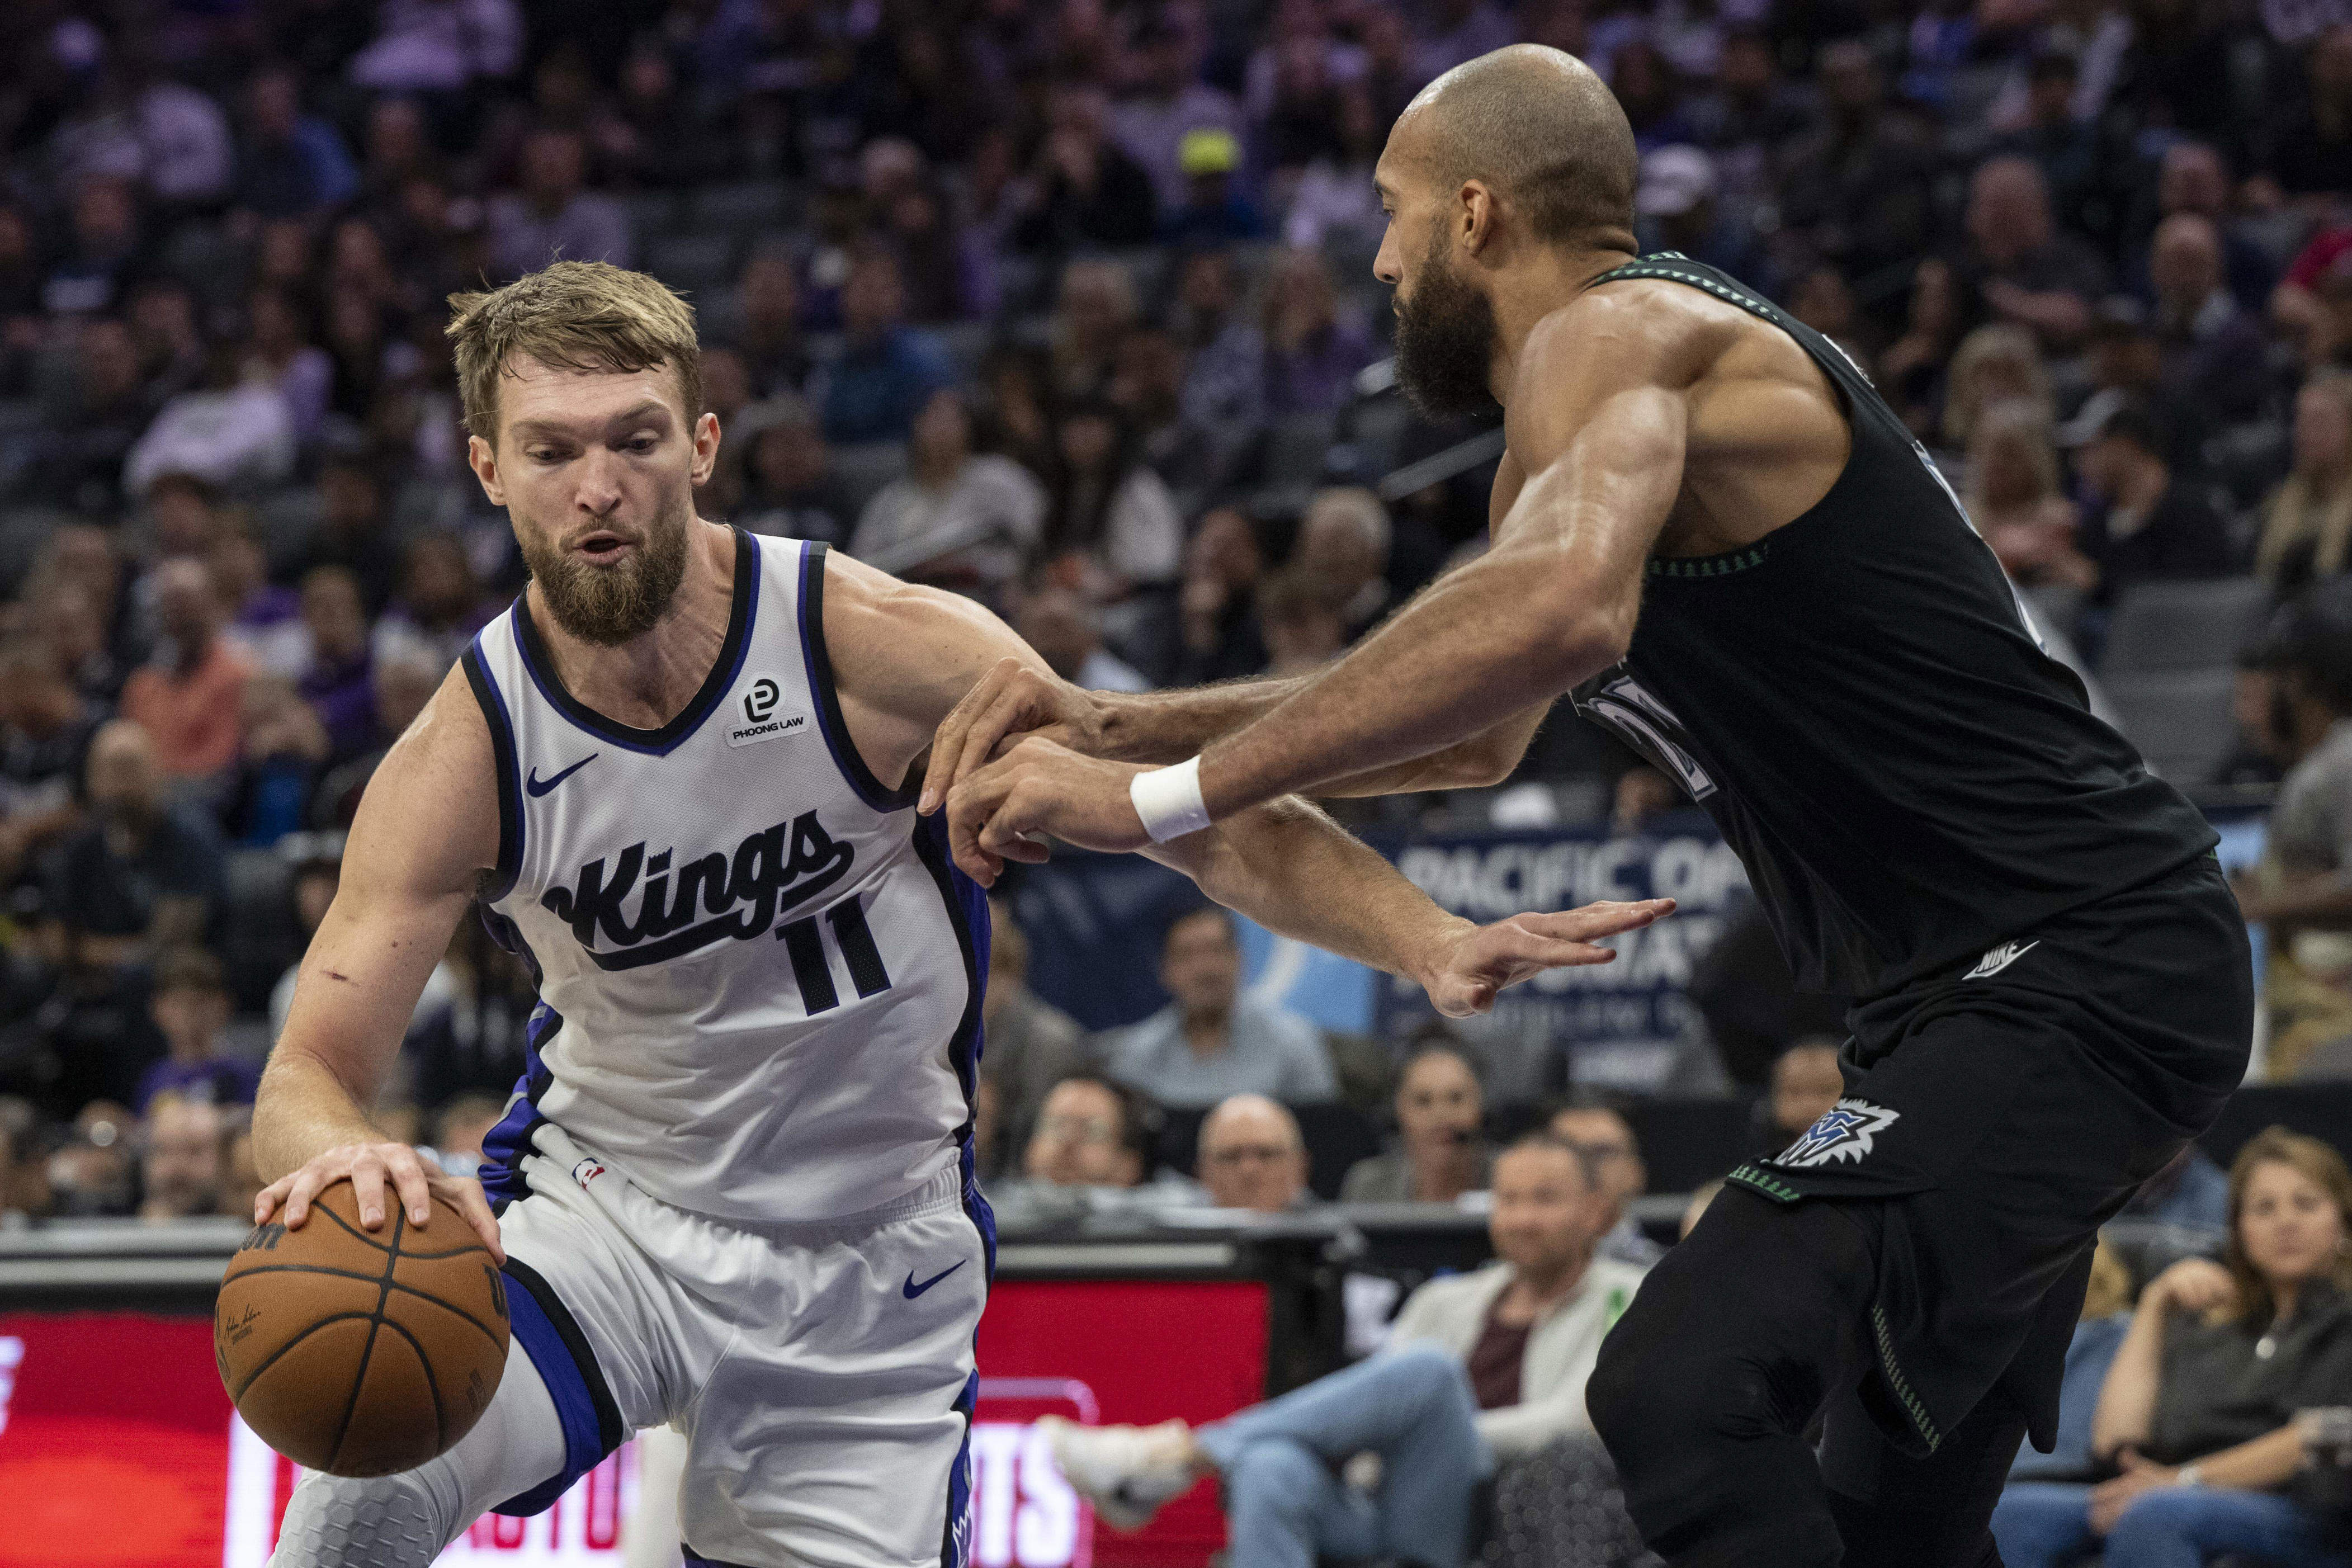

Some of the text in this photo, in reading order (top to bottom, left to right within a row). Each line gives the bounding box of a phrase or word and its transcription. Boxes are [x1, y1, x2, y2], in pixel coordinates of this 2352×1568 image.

[733, 716, 804, 740] PHOONG LAW
[541, 808, 854, 971] Kings
[774, 892, 892, 1017] 11
